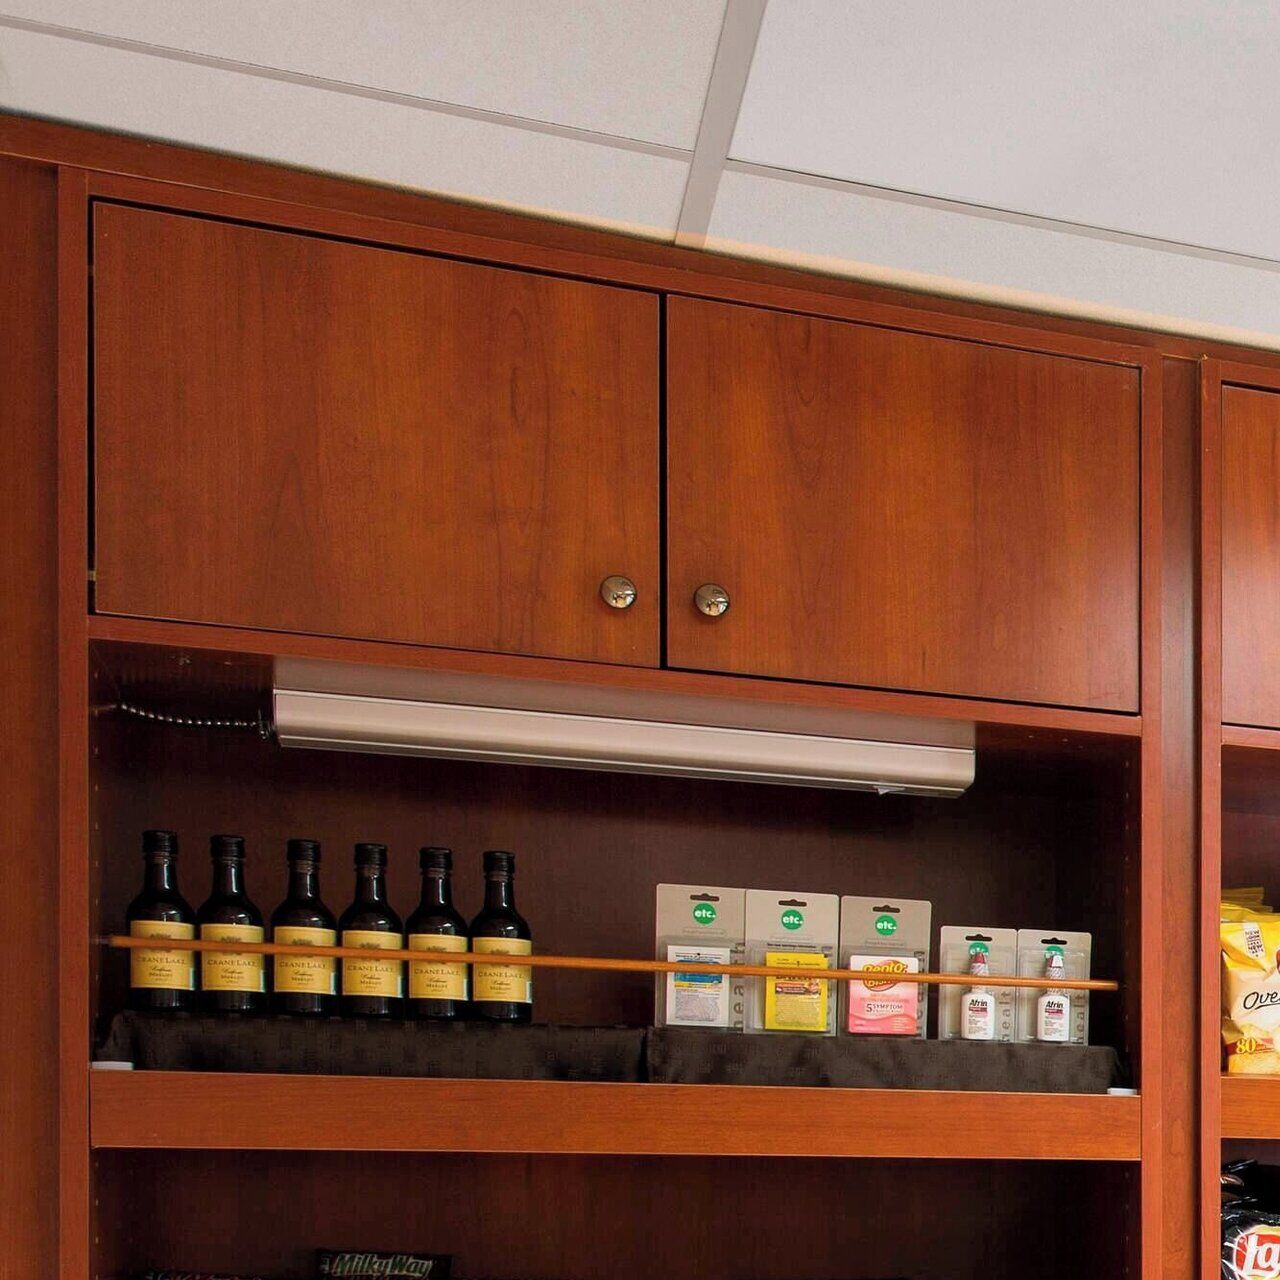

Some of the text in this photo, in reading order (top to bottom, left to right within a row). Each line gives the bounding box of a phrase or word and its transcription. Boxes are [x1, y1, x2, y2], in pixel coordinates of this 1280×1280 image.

[694, 909, 716, 918] etc.
[782, 915, 803, 925] etc.
[876, 920, 897, 930] etc.
[866, 1003, 873, 1013] 5
[969, 999, 988, 1007] Afrin
[1045, 1000, 1064, 1009] Afrin
[1236, 1038, 1257, 1054] 80
